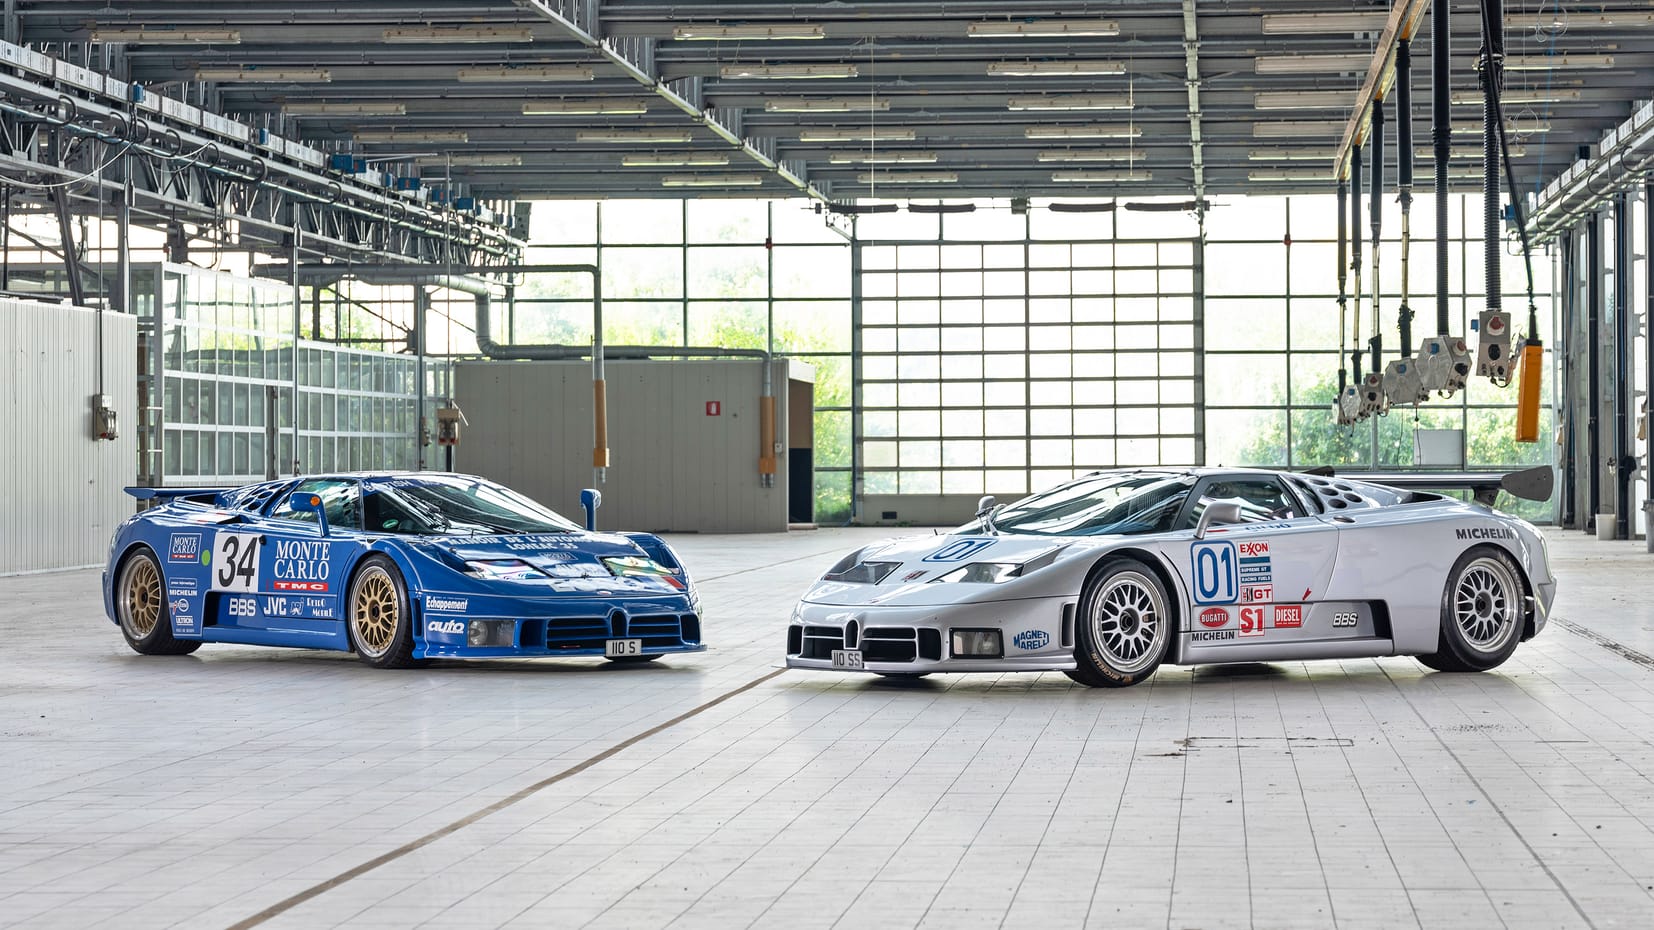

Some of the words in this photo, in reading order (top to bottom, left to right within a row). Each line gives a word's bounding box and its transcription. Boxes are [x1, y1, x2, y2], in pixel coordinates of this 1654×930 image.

[1456, 528, 1515, 540] MICHELIN
[173, 537, 197, 546] MONTE
[172, 545, 197, 554] CARLO
[275, 540, 331, 560] MONTE
[933, 540, 992, 560] 01
[1239, 542, 1269, 557] EXXON
[218, 536, 258, 588] 34
[274, 559, 329, 580] CARLO
[1197, 547, 1233, 599] 01
[169, 589, 198, 597] MICHELIN
[276, 582, 324, 590] TMC
[1253, 588, 1272, 599] GT
[229, 597, 256, 617] BBS
[263, 596, 287, 616] JVC
[1201, 613, 1227, 623] BUGATTI
[1240, 608, 1264, 633] S1
[1275, 608, 1301, 622] DIESEL
[1332, 612, 1358, 627] BBS
[428, 619, 465, 632] auto
[1191, 631, 1235, 642] MICHELIN
[612, 641, 625, 655] 110
[628, 641, 636, 654] S
[833, 652, 845, 666] 110
[847, 653, 861, 667] SS
